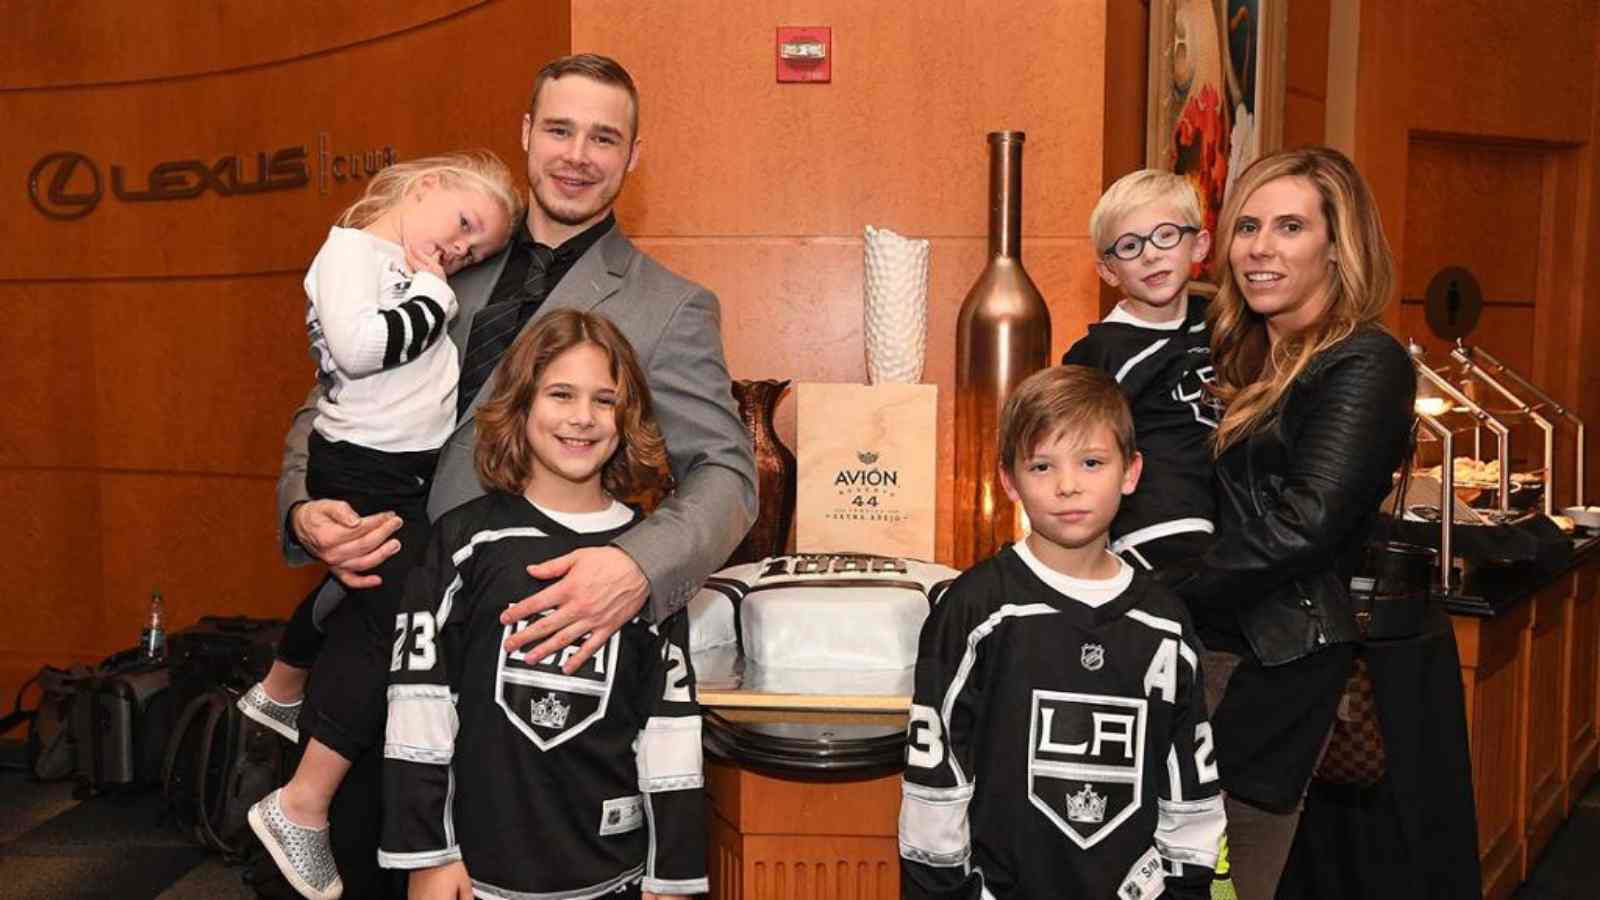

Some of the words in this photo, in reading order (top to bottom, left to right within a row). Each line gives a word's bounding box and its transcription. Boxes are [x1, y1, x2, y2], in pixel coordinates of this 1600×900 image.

[110, 145, 309, 202] LEXUS
[851, 495, 879, 507] 44
[662, 643, 691, 703] 2
[1143, 638, 1178, 704] A
[906, 703, 945, 769] 3
[1037, 707, 1136, 758] LA
[1193, 720, 1219, 784] 2
